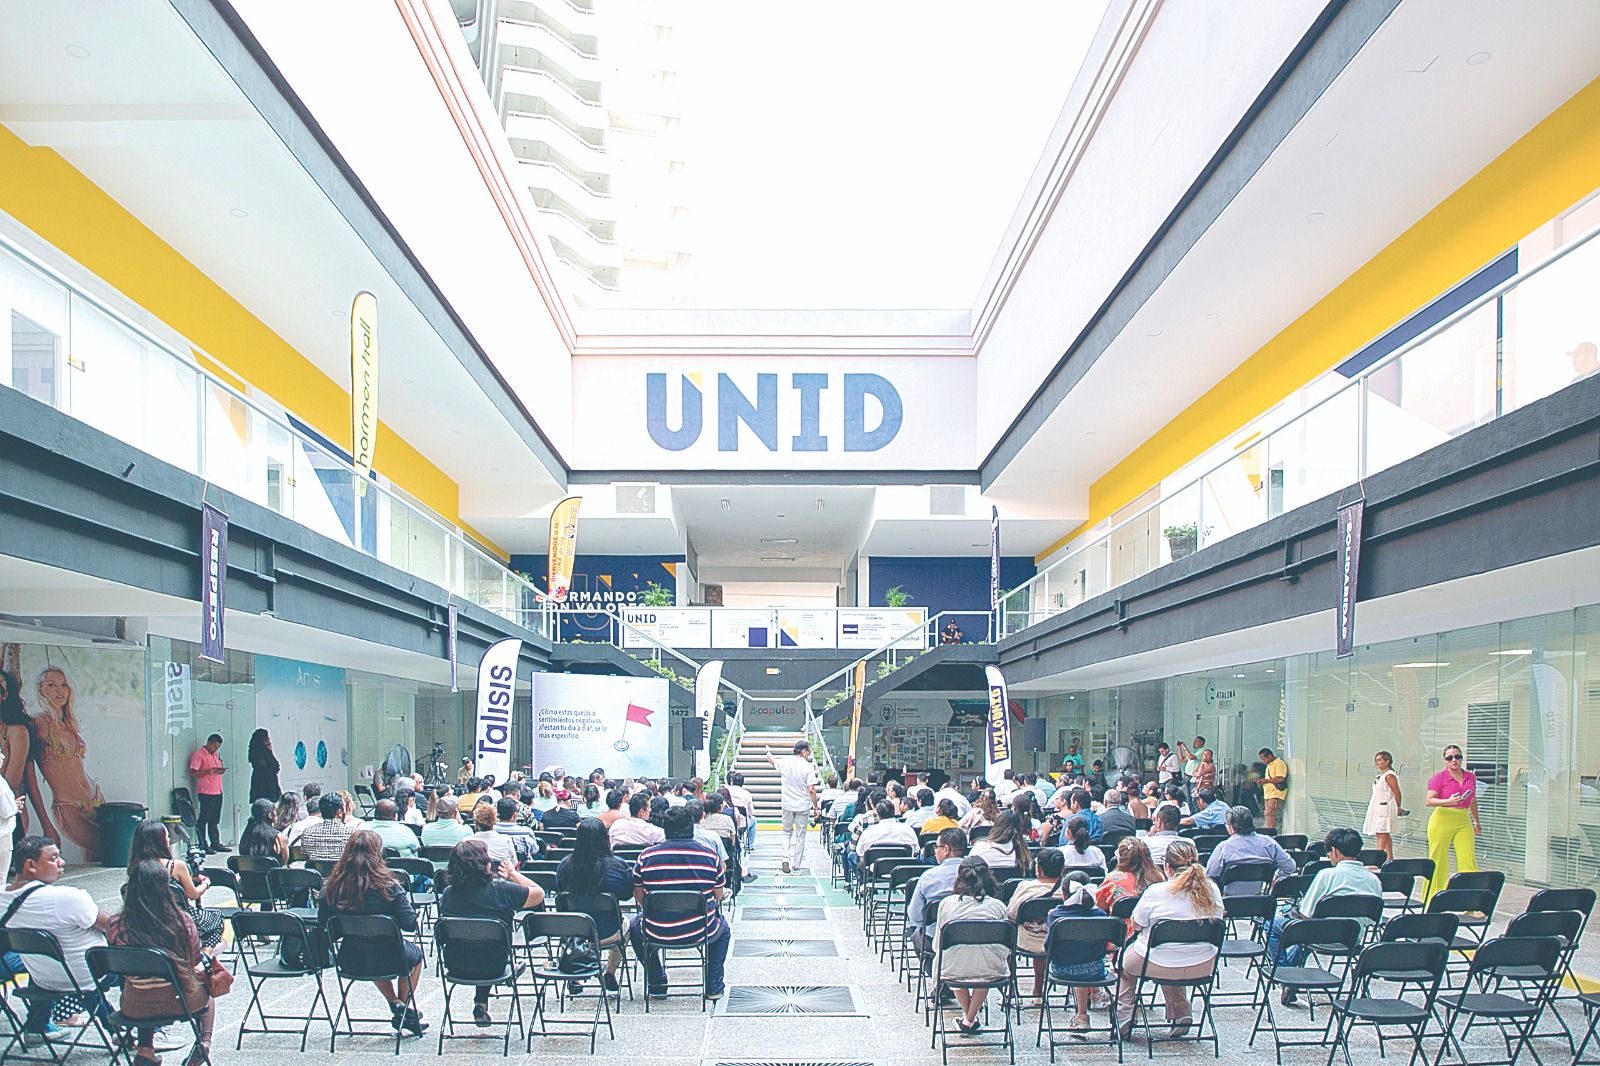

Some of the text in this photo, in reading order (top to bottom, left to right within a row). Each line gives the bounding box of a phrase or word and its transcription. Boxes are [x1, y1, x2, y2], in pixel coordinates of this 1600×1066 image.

[356, 317, 370, 468] harmon hall
[646, 373, 904, 452] UNID
[210, 528, 219, 640] RESPETO
[627, 613, 657, 623] UNID
[574, 709, 591, 717] quejas
[575, 717, 602, 725] negativos
[750, 706, 795, 716] Acapulco
[991, 688, 1007, 760] HAZLOUNID
